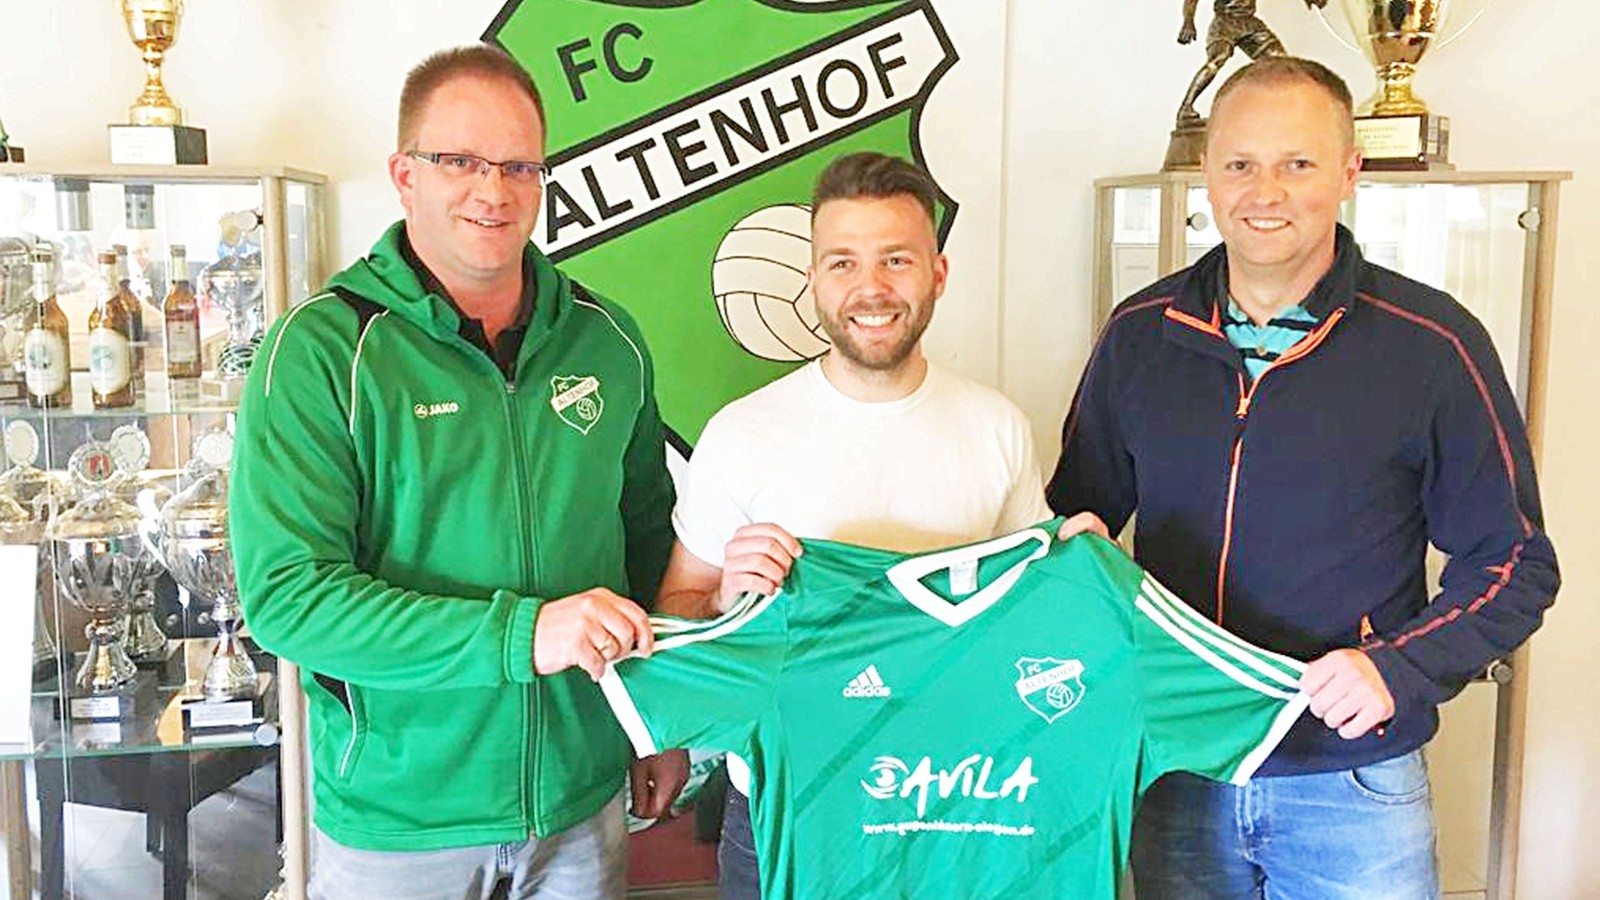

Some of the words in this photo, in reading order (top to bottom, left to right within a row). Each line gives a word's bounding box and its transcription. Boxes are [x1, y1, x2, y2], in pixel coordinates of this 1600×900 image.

[557, 22, 653, 103] FC
[546, 33, 907, 245] ALTENHOF
[557, 381, 570, 392] FC
[557, 378, 595, 407] ALTENHOF
[429, 402, 459, 416] JAKO
[1027, 663, 1041, 676] FC
[843, 684, 892, 698] adidas
